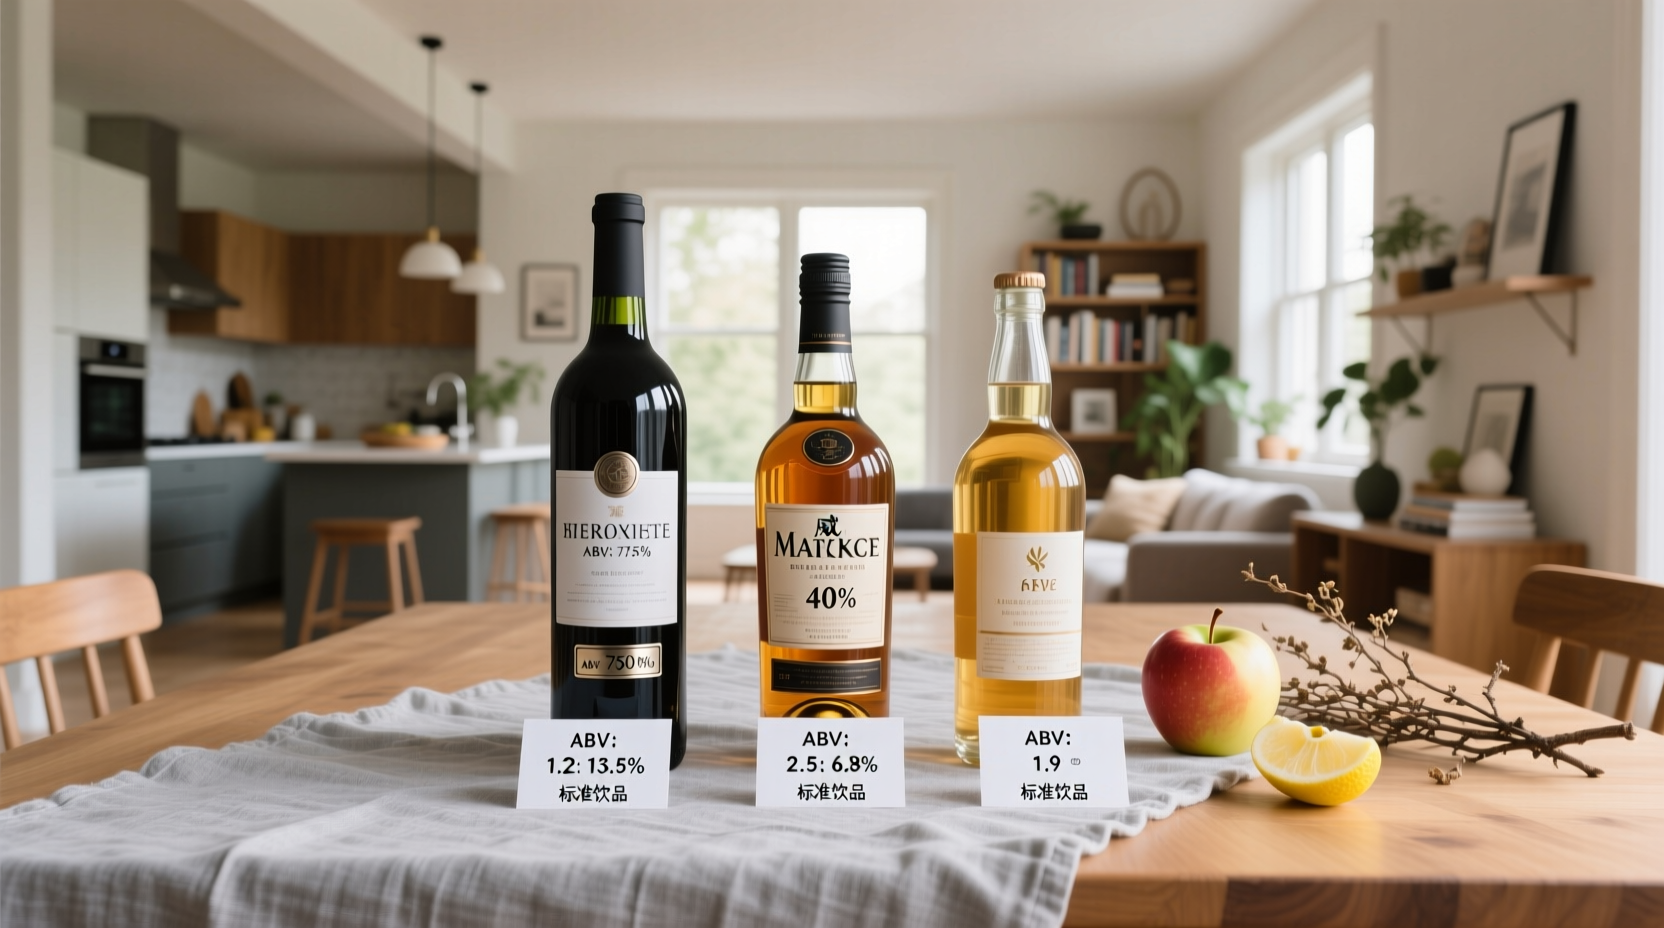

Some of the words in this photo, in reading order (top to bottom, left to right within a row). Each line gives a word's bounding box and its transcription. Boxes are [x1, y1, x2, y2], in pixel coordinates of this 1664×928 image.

[582, 545, 613, 558] ABV:
[805, 586, 857, 609] 40%
[605, 654, 635, 671] 750
[570, 732, 617, 748] ABV:
[802, 730, 849, 747] ABV:
[1024, 730, 1071, 746] ABV:
[547, 756, 581, 775] 1.2:
[587, 756, 645, 775] 13.5%
[786, 755, 825, 773] 2.5:
[831, 755, 878, 773] 6.8%
[1033, 754, 1061, 773] 1.9
[558, 783, 628, 803] 标准饮品
[797, 782, 866, 802] 标准饮品
[1020, 782, 1088, 801] 标准饮品
